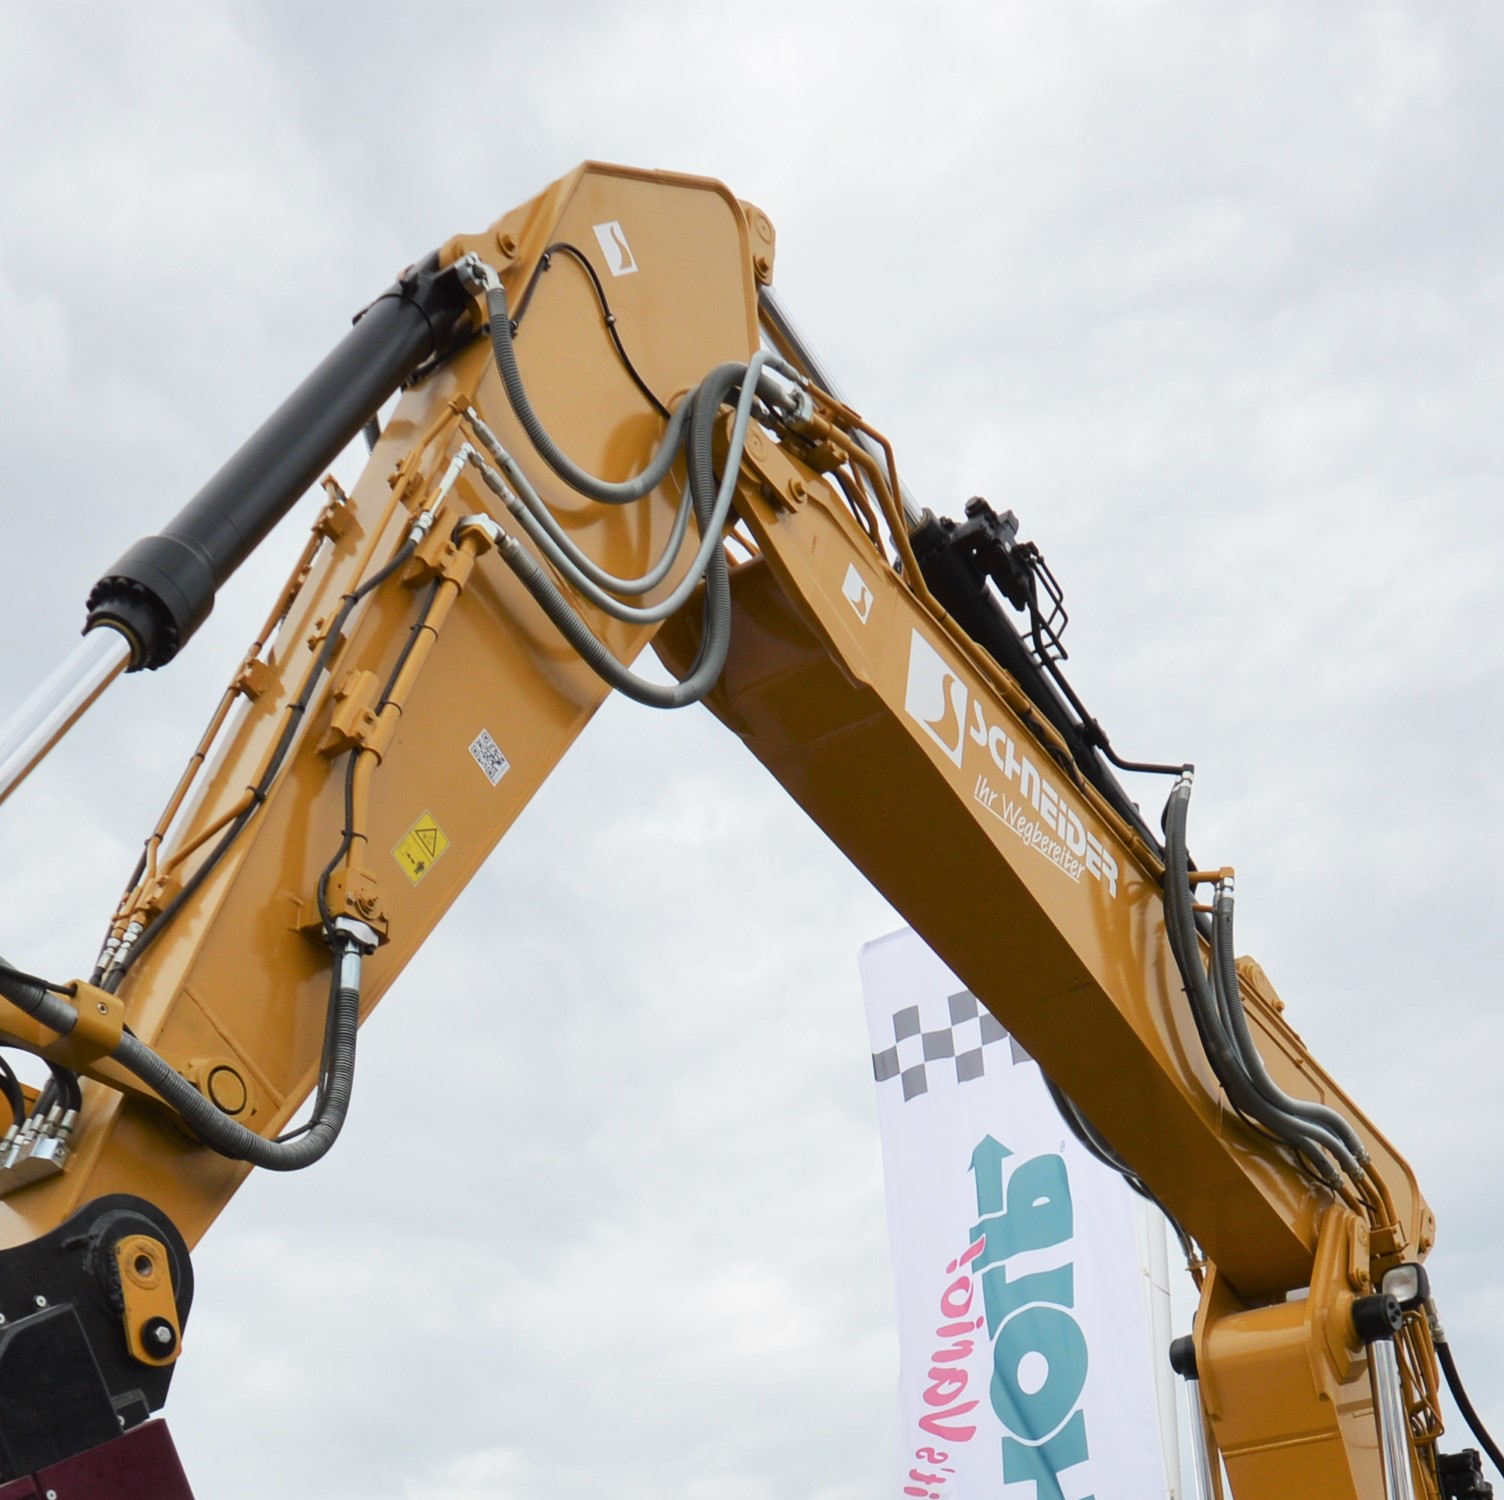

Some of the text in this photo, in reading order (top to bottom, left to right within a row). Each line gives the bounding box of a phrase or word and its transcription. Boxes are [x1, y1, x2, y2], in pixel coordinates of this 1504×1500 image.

[969, 699, 1119, 898] SCHNEIDER
[973, 773, 1086, 882] Ihr Wegbereiter
